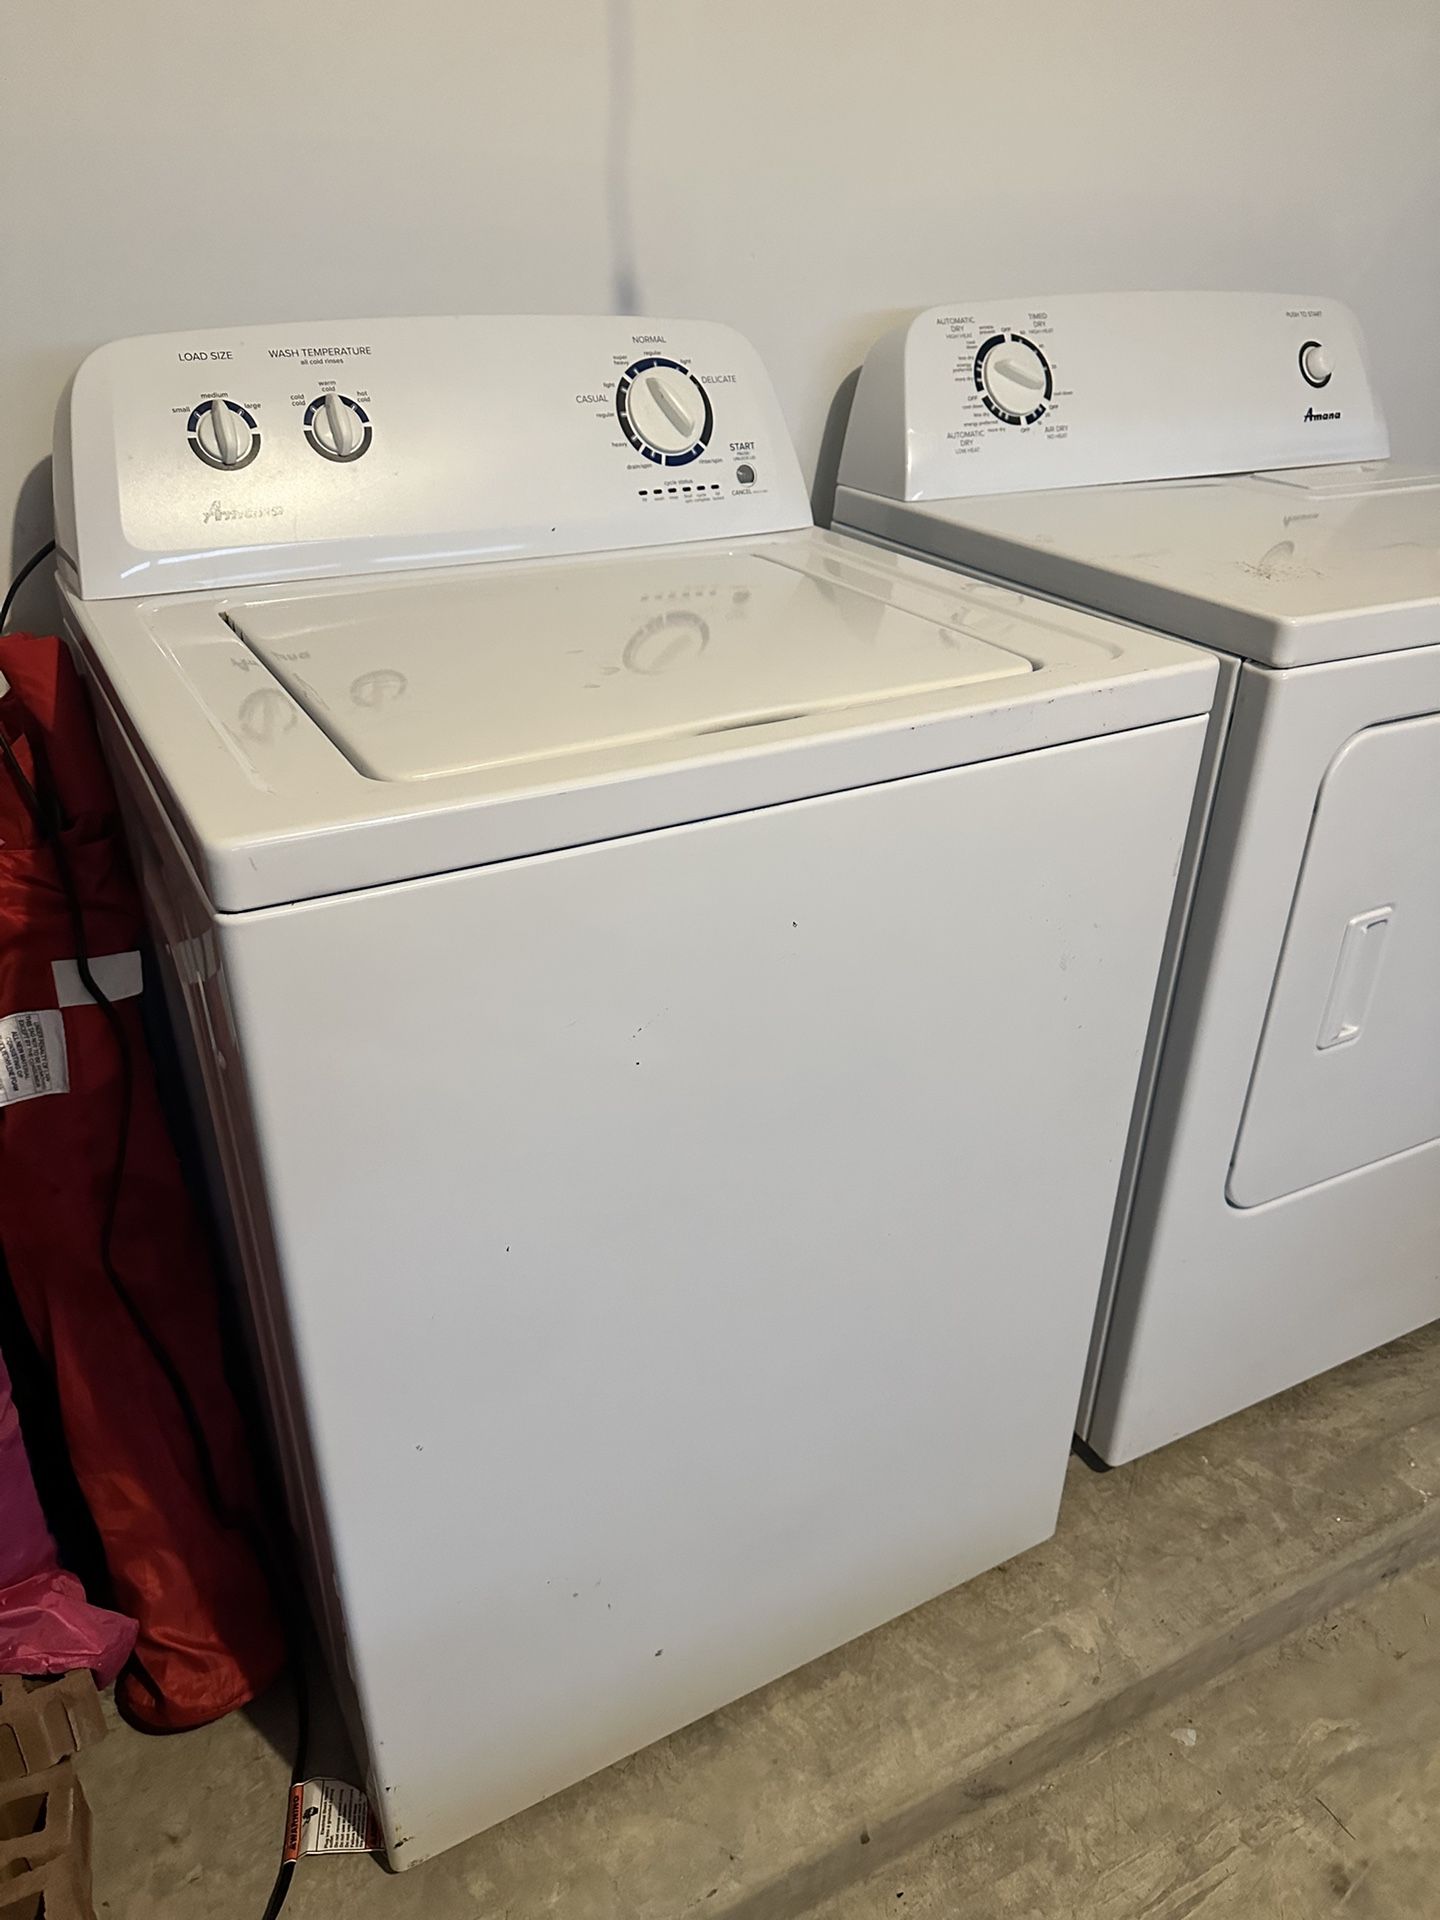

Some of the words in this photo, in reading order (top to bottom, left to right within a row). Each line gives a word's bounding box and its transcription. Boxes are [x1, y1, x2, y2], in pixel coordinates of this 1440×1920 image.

[936, 316, 975, 325] AUTOMATIC
[1028, 312, 1048, 320] TIMED
[1032, 320, 1046, 328] DRY
[632, 336, 667, 344] NORMAL
[178, 352, 207, 361] LOAD
[210, 351, 233, 360] SIZE
[268, 349, 299, 358] WASH
[300, 347, 371, 357] TEMPERATURE
[701, 375, 737, 383] DELICATE
[576, 395, 609, 403] CASUAL
[1304, 407, 1341, 422] Amana
[947, 430, 985, 439] AUTOMATIC
[729, 441, 755, 451] START
[960, 439, 973, 447] DRY
[290, 1795, 300, 1842] WARNING
